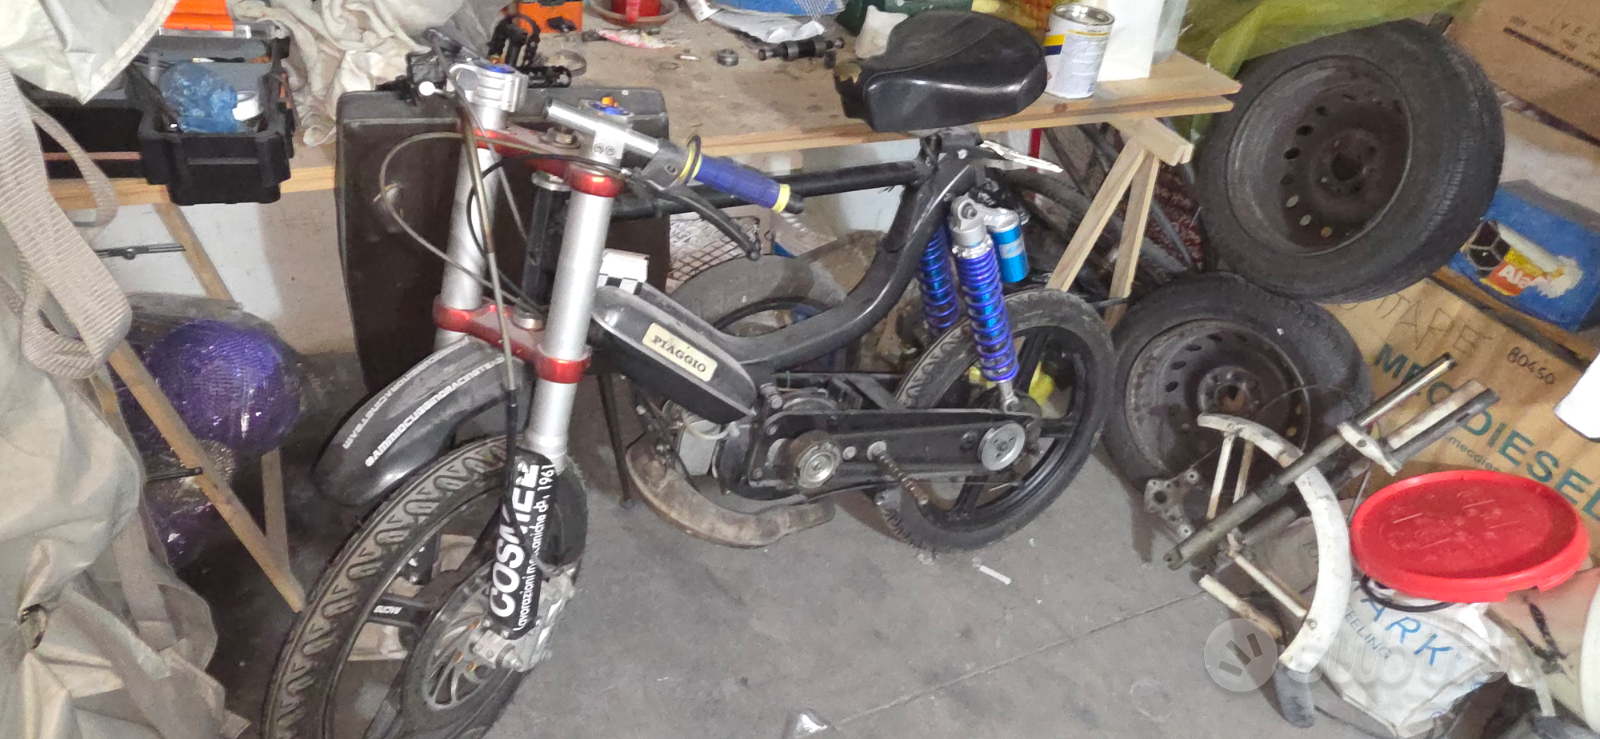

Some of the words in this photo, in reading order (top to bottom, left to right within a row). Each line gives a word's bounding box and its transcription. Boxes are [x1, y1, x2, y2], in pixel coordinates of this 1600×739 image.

[651, 335, 706, 373] PIAGGIO
[537, 463, 554, 492] 1961
[1345, 602, 1392, 660] EELING
